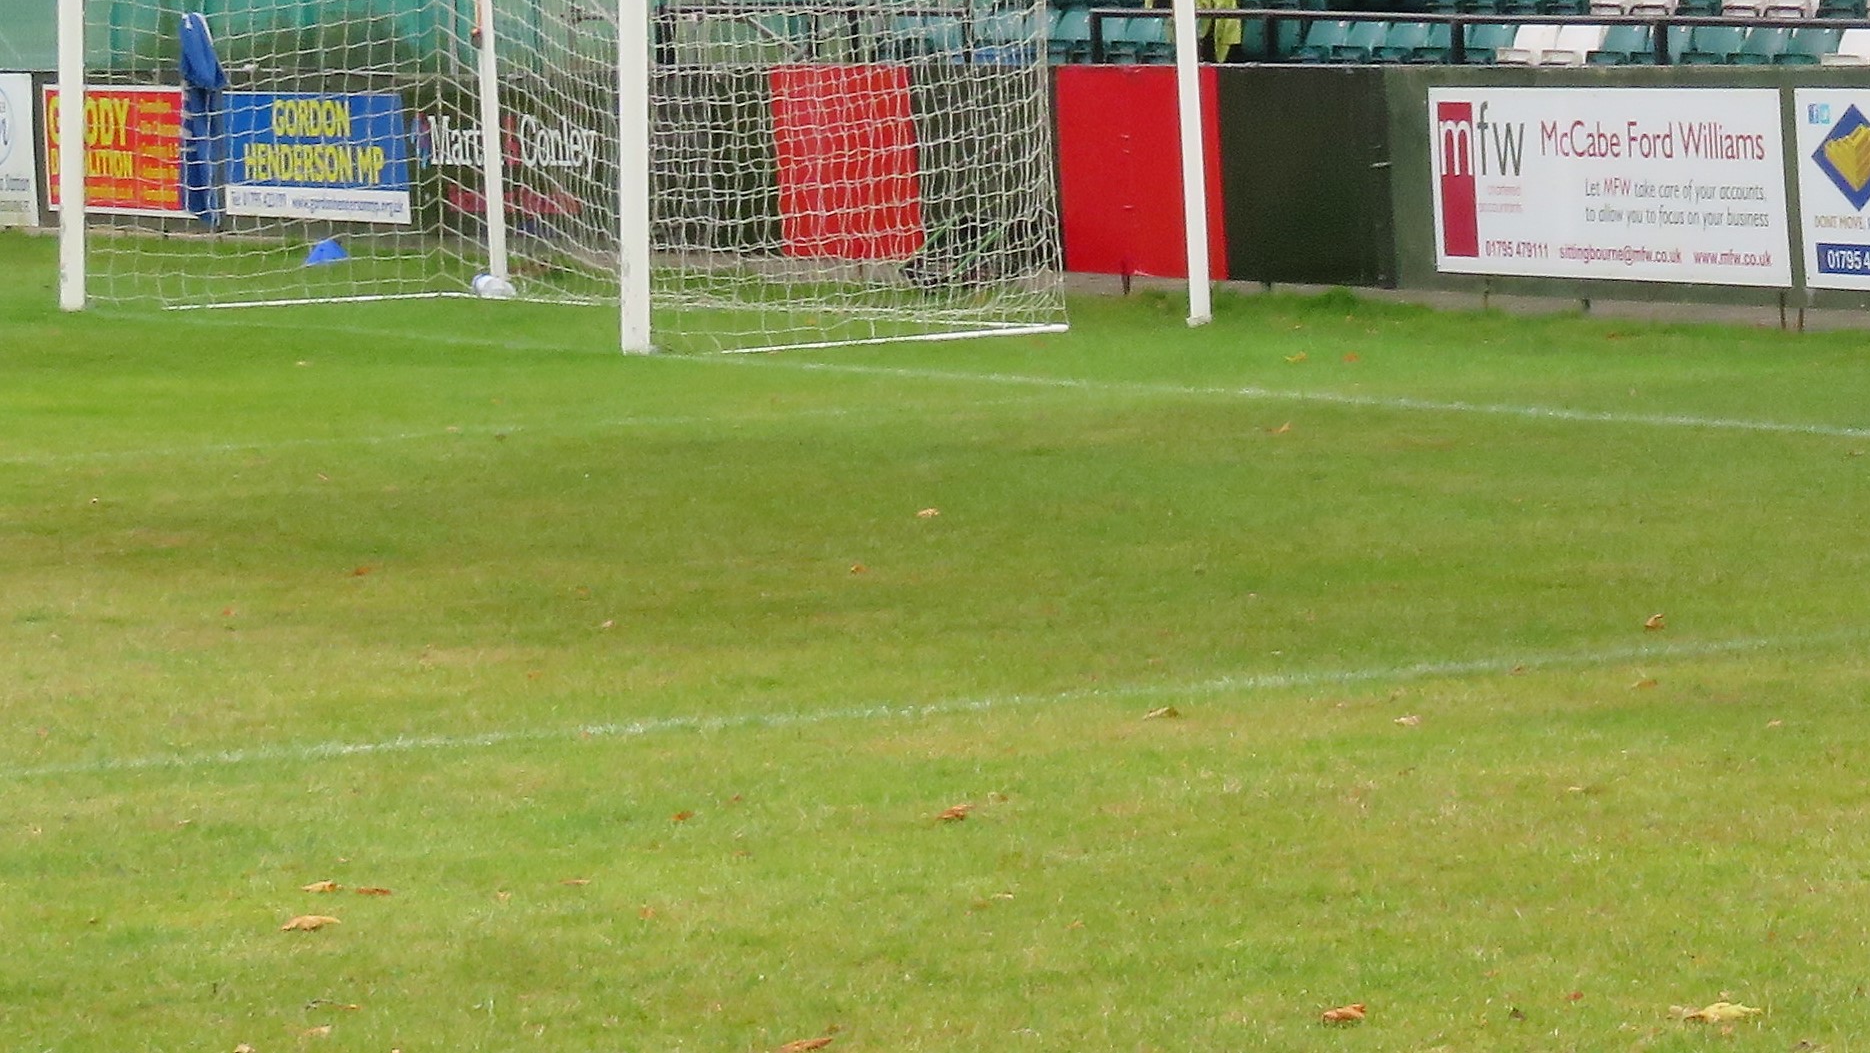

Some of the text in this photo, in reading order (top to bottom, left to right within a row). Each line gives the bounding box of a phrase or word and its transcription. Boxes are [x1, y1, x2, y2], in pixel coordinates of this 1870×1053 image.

[272, 98, 352, 138] GORDON
[519, 113, 598, 182] Conley
[1438, 101, 1525, 177] mfw
[1540, 119, 1766, 161] McCabe Ford Williams
[243, 143, 386, 185] HENDERSON MP
[1585, 178, 1601, 198] Let
[1603, 178, 1632, 197] MFW
[1634, 179, 1656, 199] take
[1658, 184, 1680, 200] care
[1682, 179, 1694, 203] of
[1694, 184, 1717, 205] your
[1585, 203, 1770, 231] to allow you to focus on your business
[1485, 239, 1513, 258] 01795
[1515, 240, 1550, 259] 479111
[1692, 248, 1774, 268] www.mfw.co.uk
[1826, 249, 1862, 270] 01795
